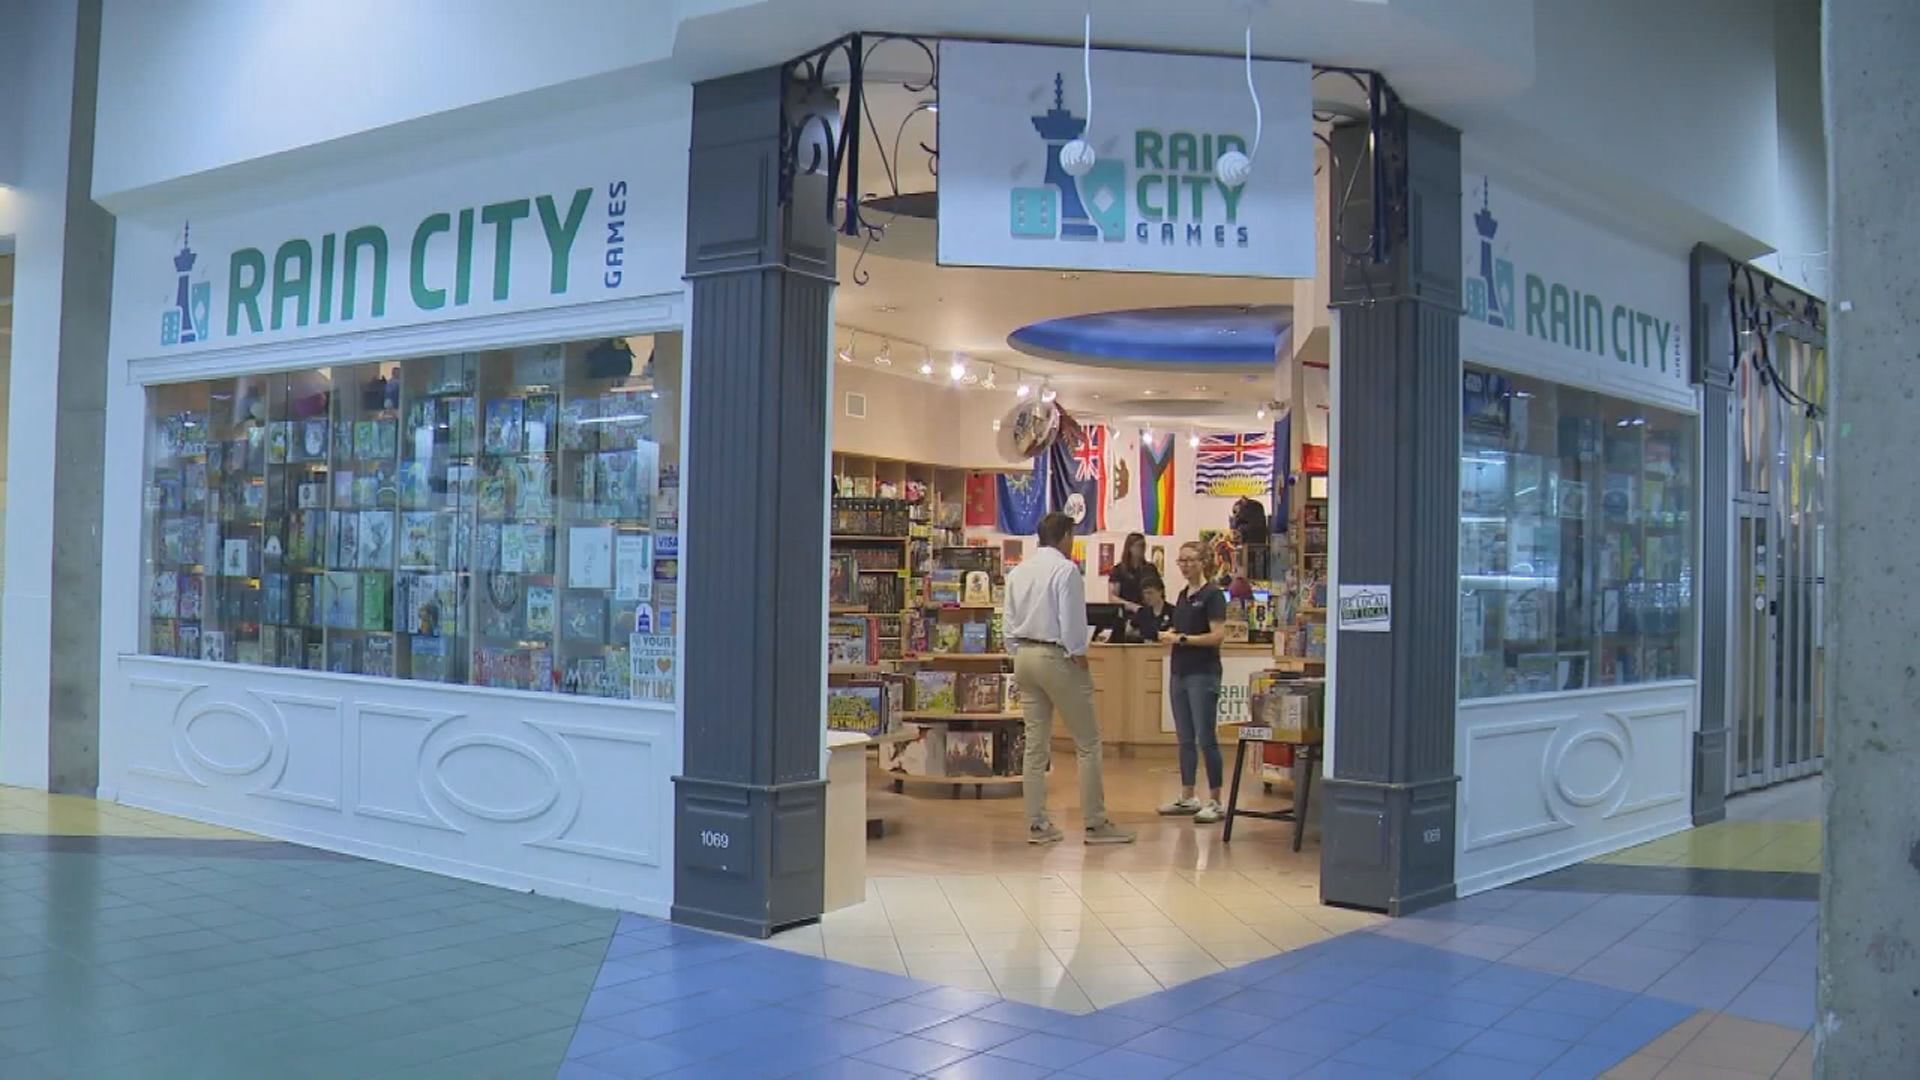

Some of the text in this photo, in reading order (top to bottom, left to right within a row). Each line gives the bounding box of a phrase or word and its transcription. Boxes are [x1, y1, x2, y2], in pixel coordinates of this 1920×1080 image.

[1135, 130, 1247, 171] RAIN
[1136, 174, 1247, 222] CITY
[604, 180, 627, 289] GAMES
[1136, 223, 1248, 246] GAMES
[226, 187, 594, 336] RAIN CITY
[1525, 273, 1671, 373] RAIN CITY
[643, 636, 671, 648] YOUR
[701, 830, 729, 848] 1069
